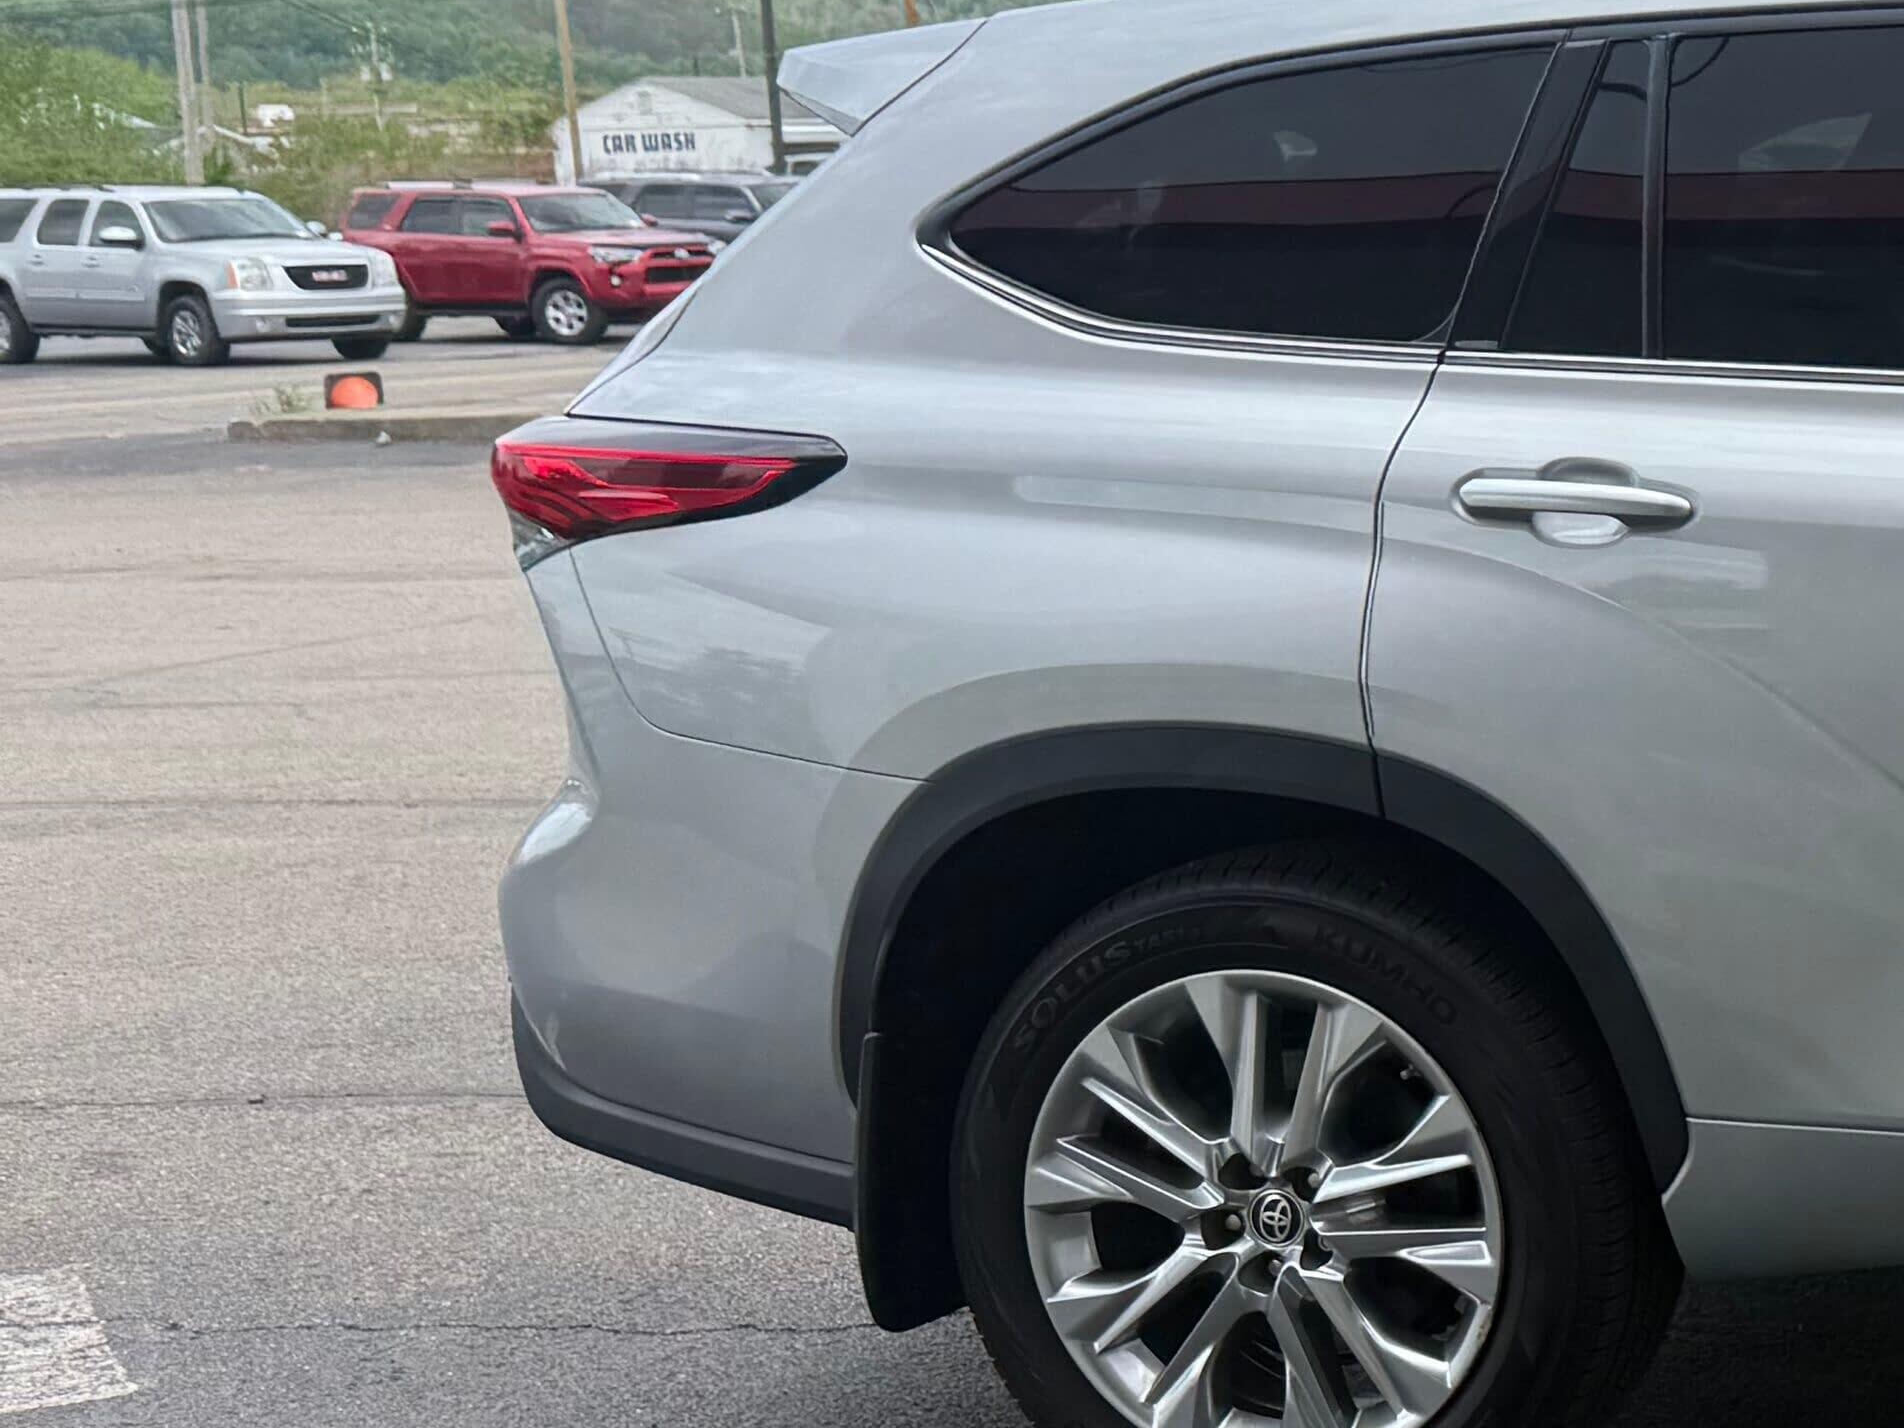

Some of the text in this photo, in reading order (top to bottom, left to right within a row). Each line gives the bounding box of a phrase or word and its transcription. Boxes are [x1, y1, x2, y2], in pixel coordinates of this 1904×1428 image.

[603, 132, 696, 154] CAR WASH
[1013, 939, 1132, 1054] SOLUS
[1313, 922, 1458, 1026] KUMHO
